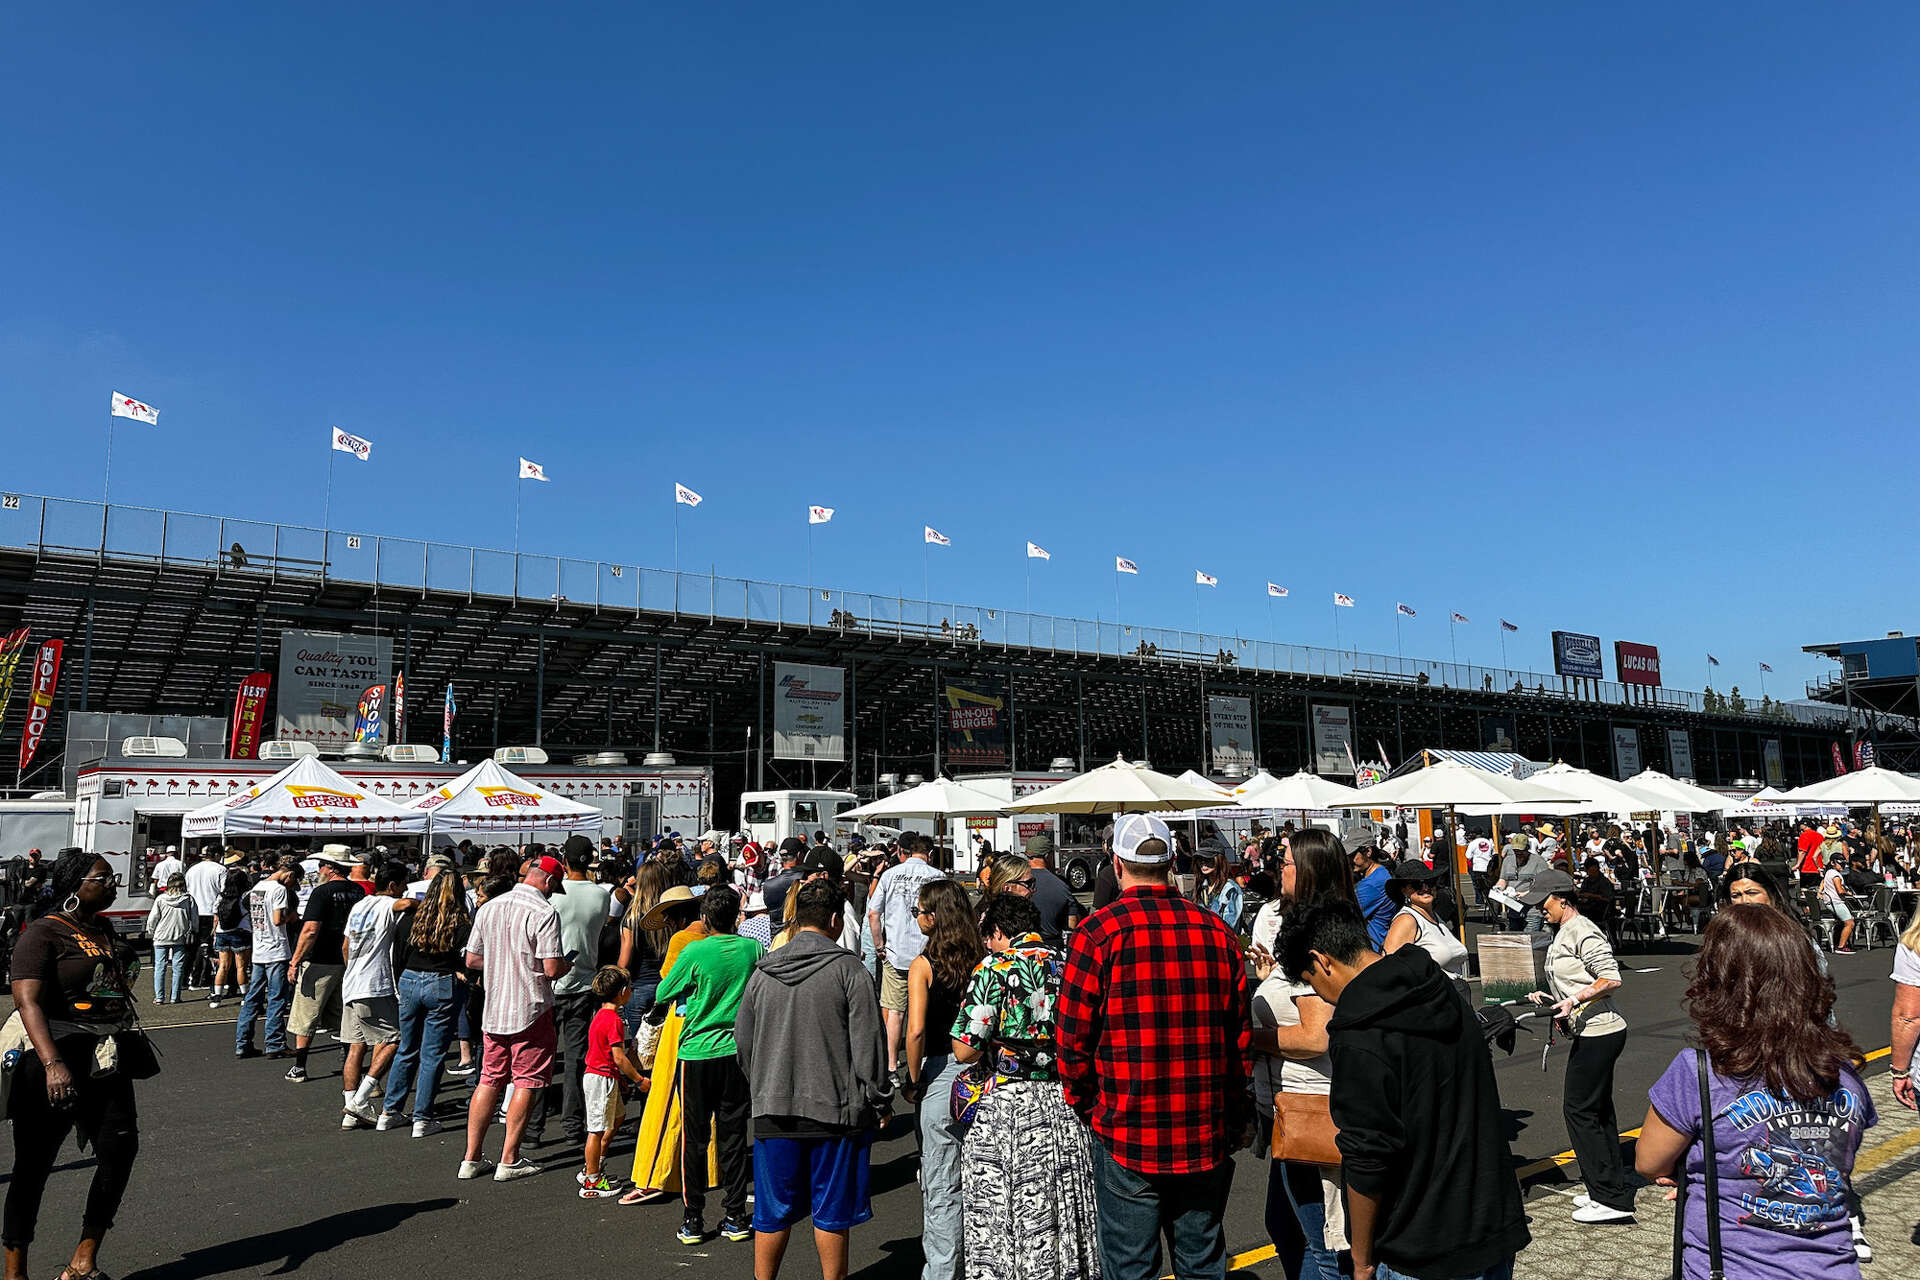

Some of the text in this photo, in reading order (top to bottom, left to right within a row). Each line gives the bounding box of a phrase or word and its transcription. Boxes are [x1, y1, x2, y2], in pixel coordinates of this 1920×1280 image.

[4, 496, 18, 508] 22
[349, 537, 359, 548] 21
[297, 649, 377, 667] Quality YOU
[1623, 654, 1658, 672] LUCAS OIL
[39, 647, 55, 691] HOT
[294, 666, 377, 680] CAN TASTE
[243, 686, 266, 698] BEST
[366, 687, 381, 733] SNOW
[951, 708, 993, 719] IN-N-OUT
[237, 698, 258, 757] FRIES
[953, 717, 993, 729] BURGER
[296, 795, 353, 803] IN-N-OUT
[1766, 1114, 1850, 1133] INDIANA
[1790, 1126, 1830, 1139] 2022
[1741, 1192, 1845, 1225] LEGEND
